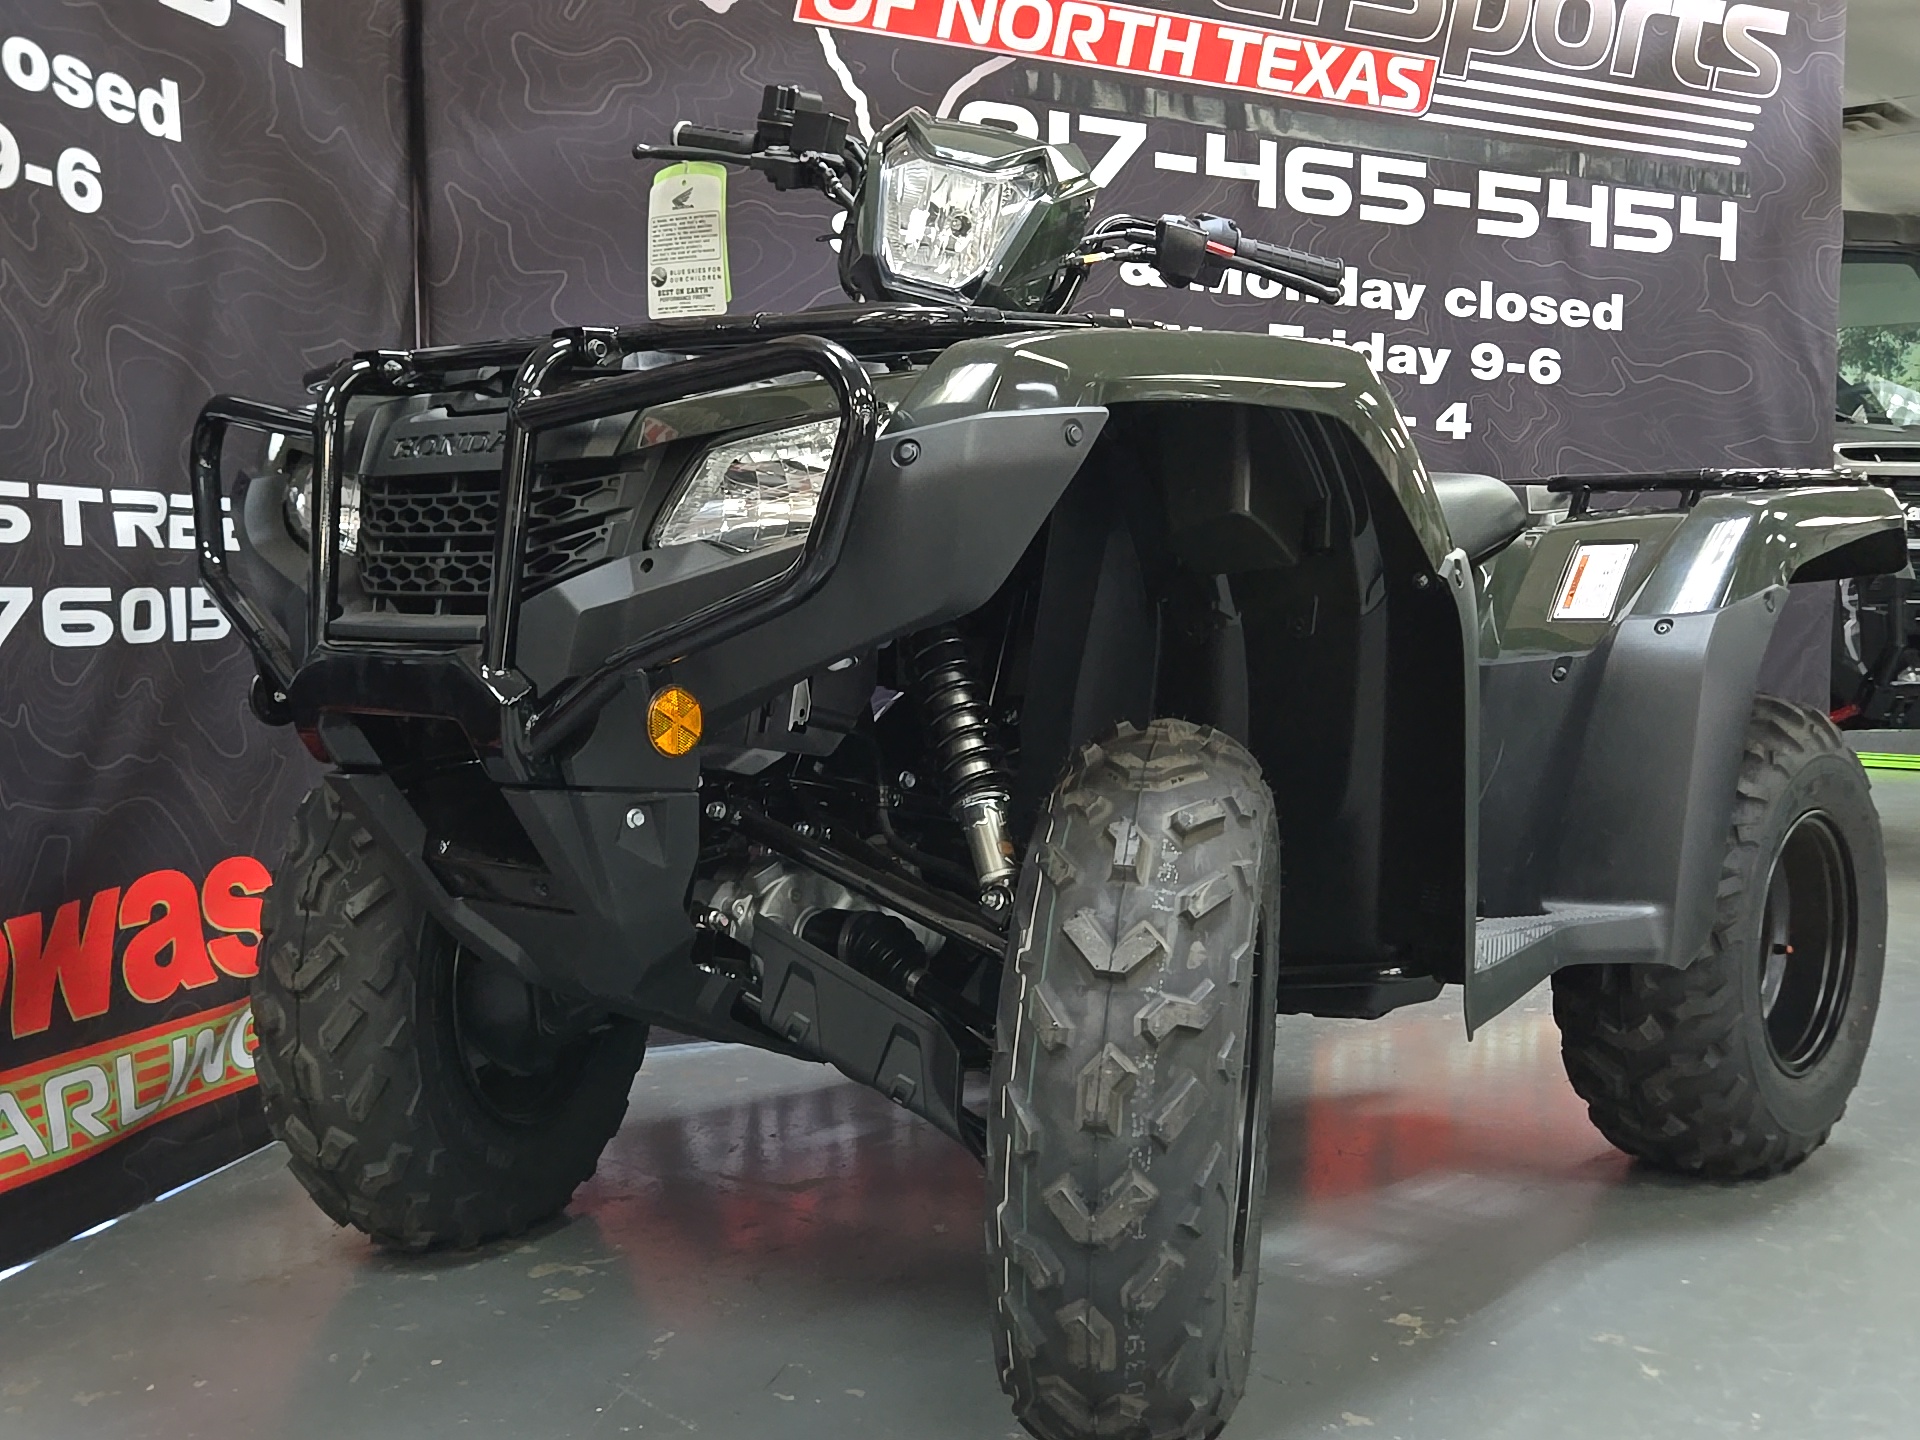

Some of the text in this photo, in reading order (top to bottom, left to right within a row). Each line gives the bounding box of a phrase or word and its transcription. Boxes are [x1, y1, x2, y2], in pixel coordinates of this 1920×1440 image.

[936, 0, 1202, 77] NORTH
[1217, 27, 1425, 110] TEXAS
[1445, 281, 1624, 331] closed
[1470, 342, 1562, 385] 9-6
[1436, 402, 1472, 440] 4
